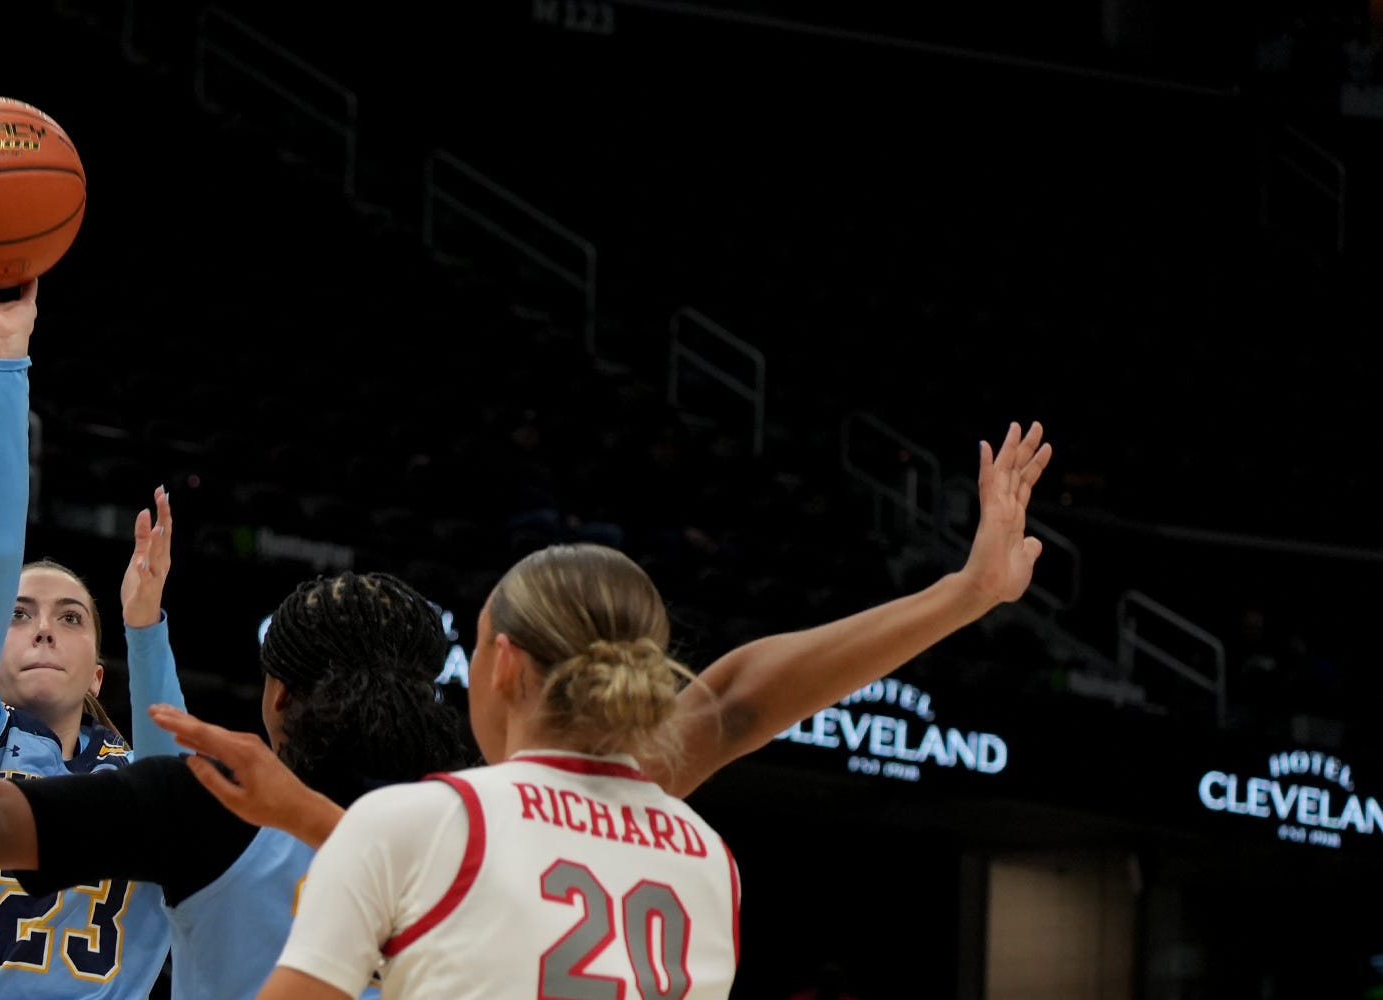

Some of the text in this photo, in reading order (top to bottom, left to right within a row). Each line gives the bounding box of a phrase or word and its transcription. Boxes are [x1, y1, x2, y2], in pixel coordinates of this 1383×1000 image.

[774, 706, 1008, 775] LEVELAND
[1269, 750, 1355, 792] HOTEL
[512, 782, 708, 859] RICHARD
